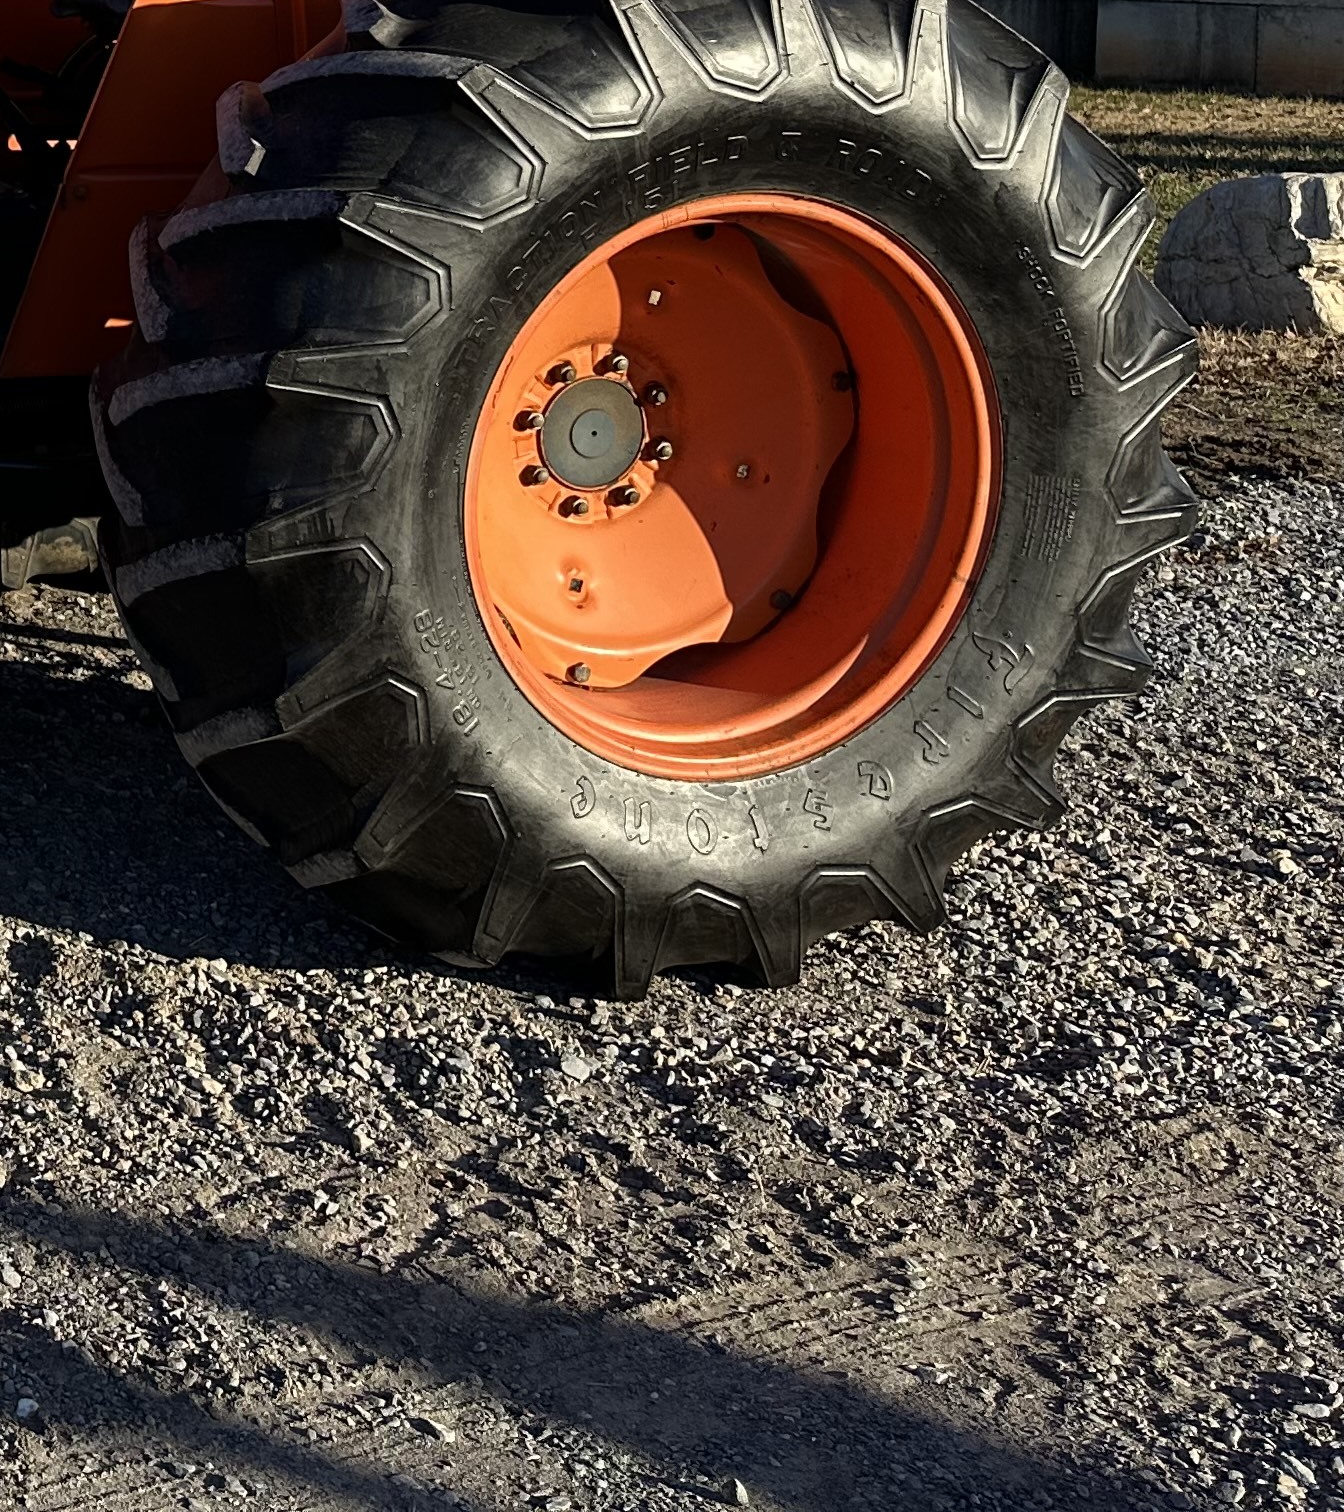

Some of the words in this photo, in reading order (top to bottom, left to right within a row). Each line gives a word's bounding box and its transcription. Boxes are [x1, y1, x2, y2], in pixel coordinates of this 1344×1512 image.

[454, 190, 603, 370] TRACTION
[627, 135, 748, 188] FIELD
[828, 138, 933, 197] ROAD
[1049, 307, 1085, 396] FORTIFIED
[414, 608, 480, 737] 18.4-28
[568, 632, 1035, 856] Firestone
